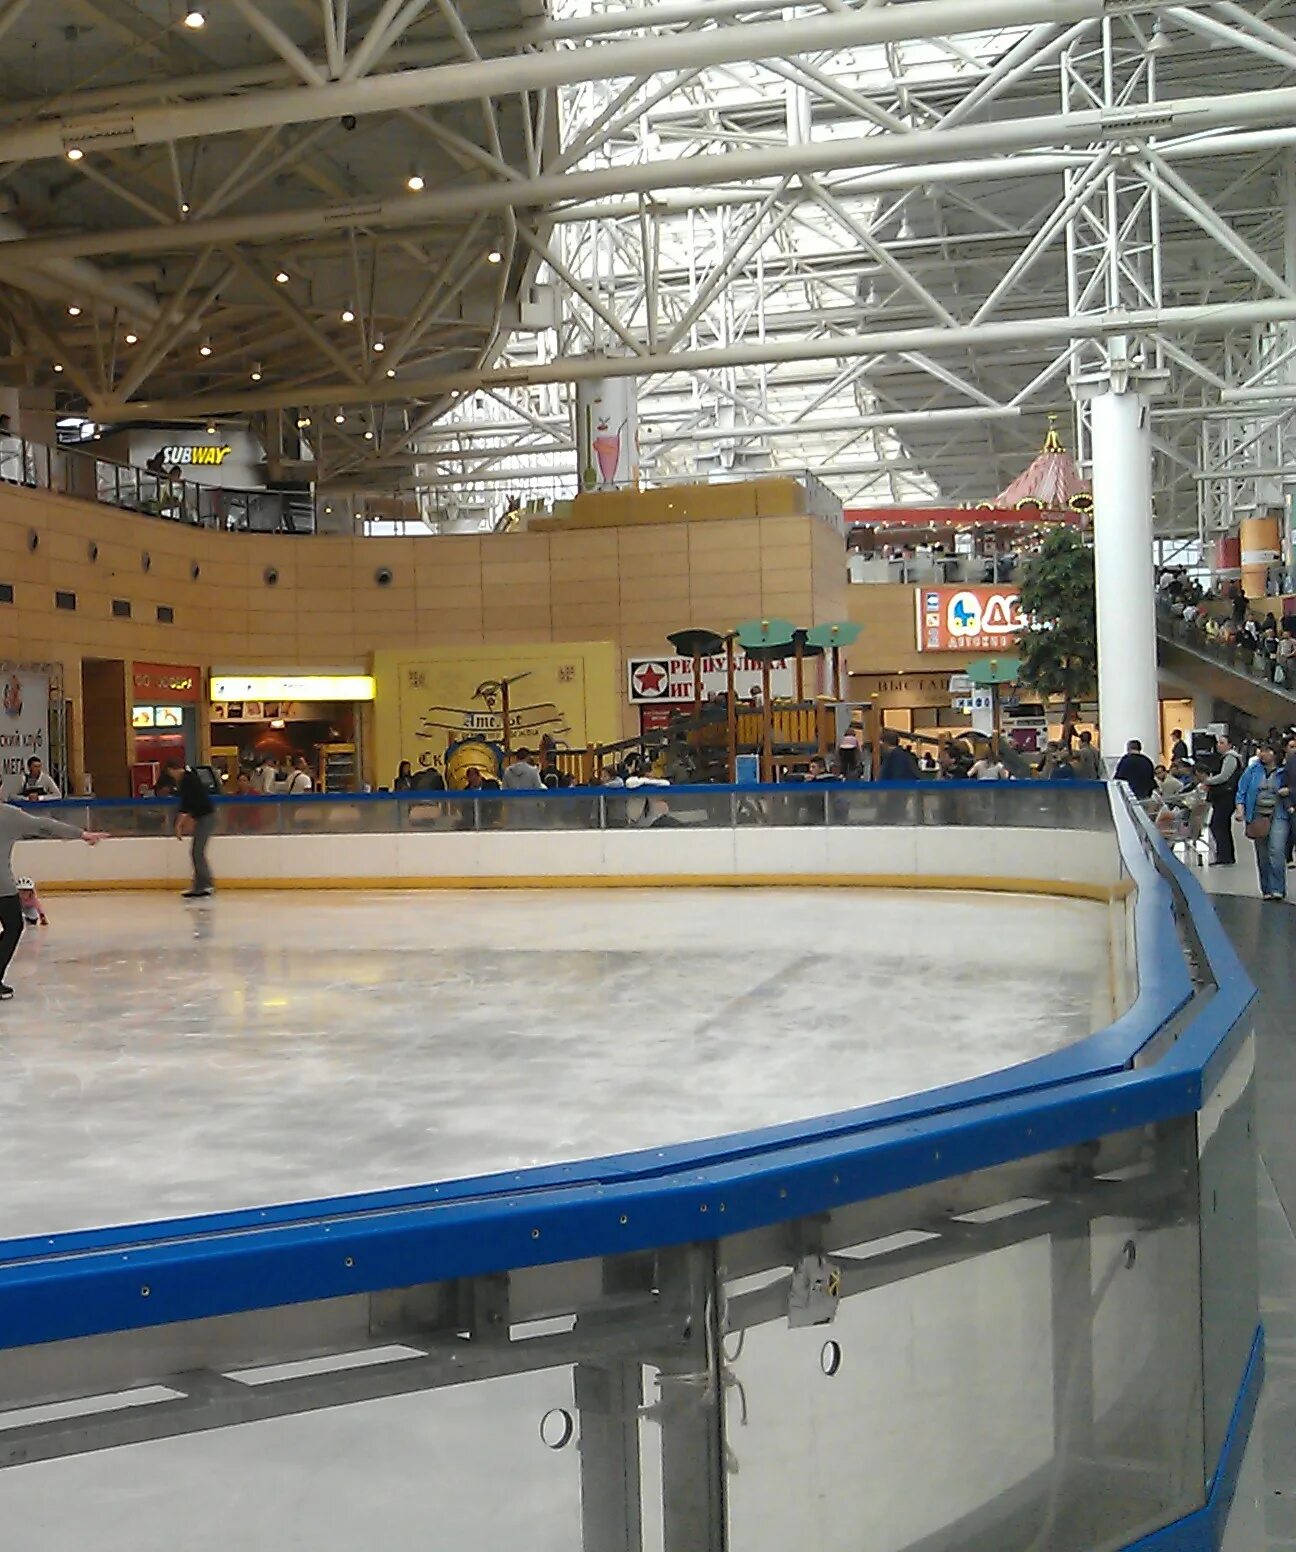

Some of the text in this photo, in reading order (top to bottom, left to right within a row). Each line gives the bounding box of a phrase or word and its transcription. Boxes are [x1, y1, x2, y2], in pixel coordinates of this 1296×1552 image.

[163, 446, 232, 464] SUBWAY
[670, 657, 787, 675] РЕПУЛИА
[464, 713, 522, 728] Атеье
[23, 728, 43, 754] клуб
[3, 758, 25, 775] МЕГА
